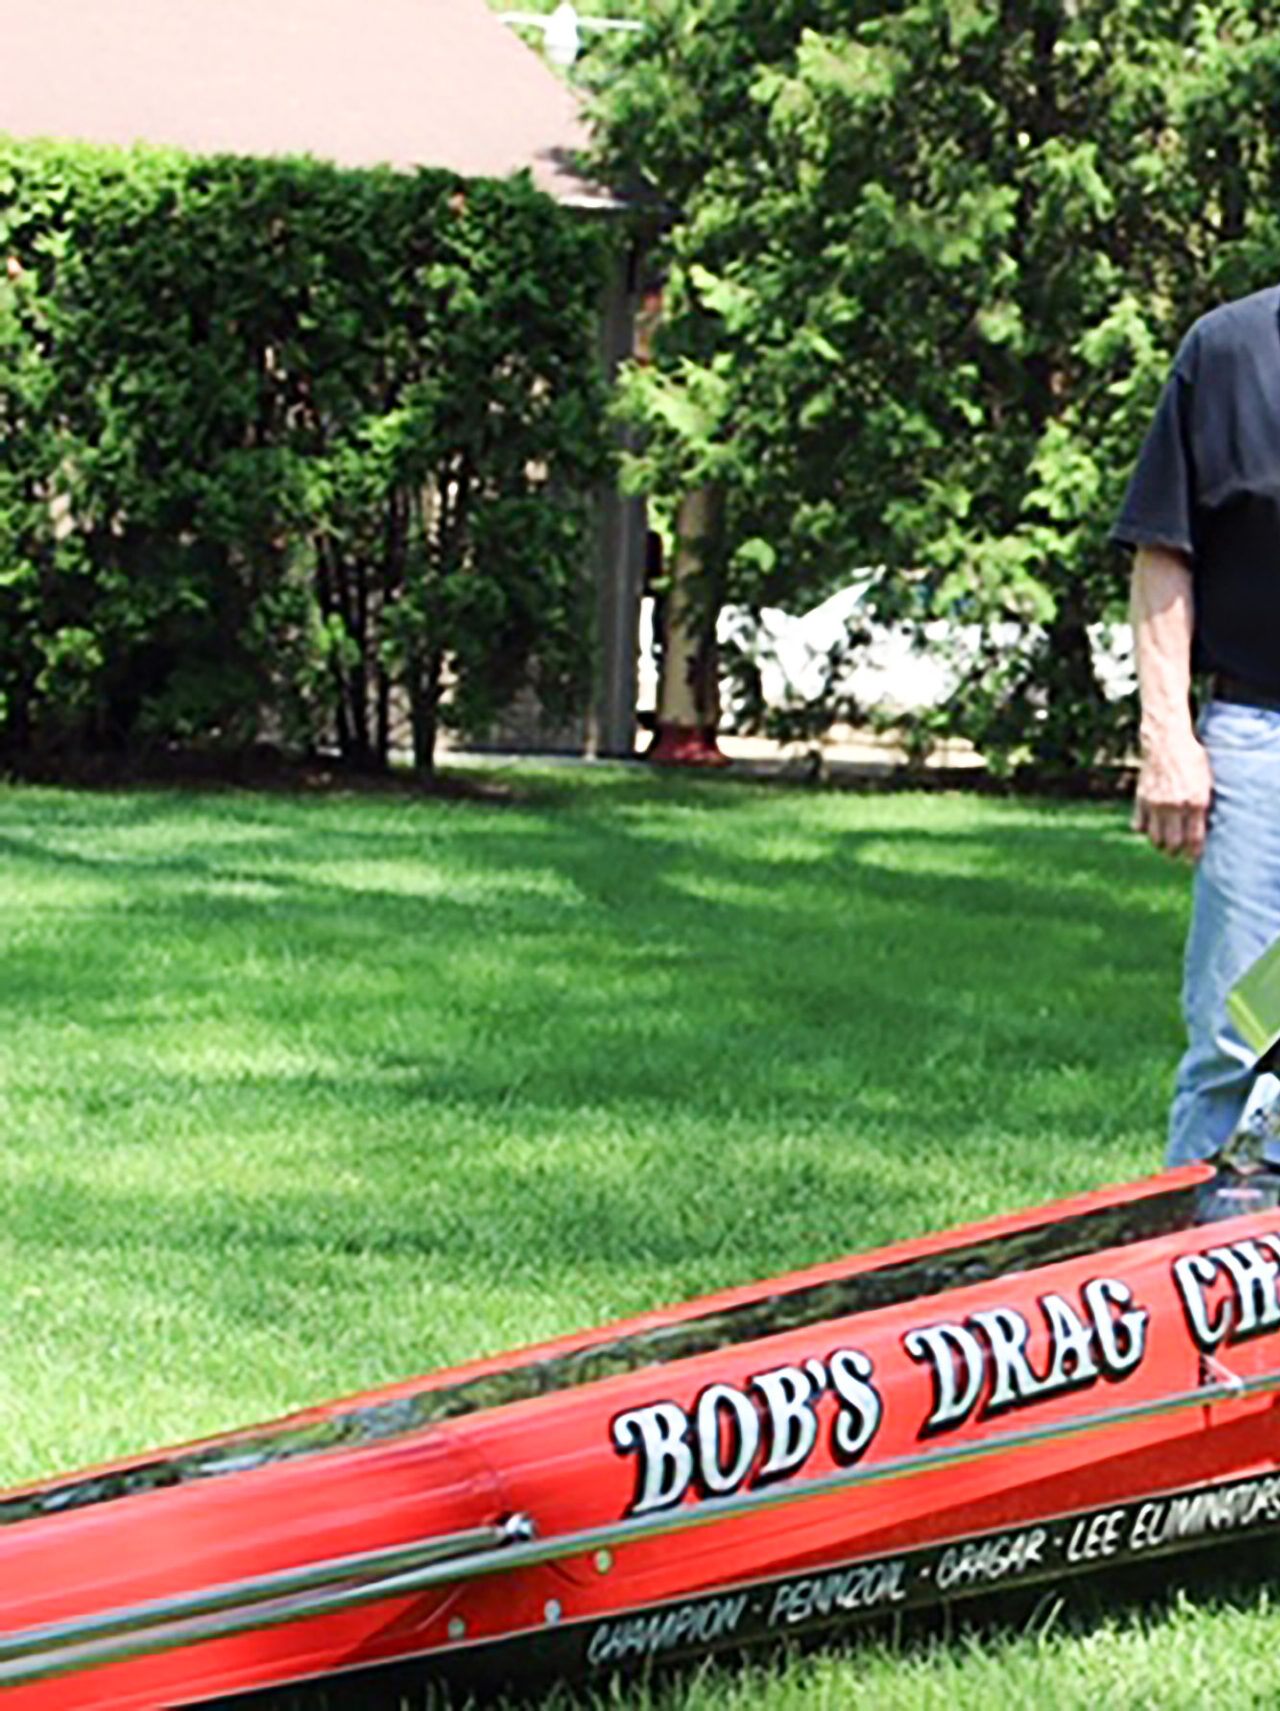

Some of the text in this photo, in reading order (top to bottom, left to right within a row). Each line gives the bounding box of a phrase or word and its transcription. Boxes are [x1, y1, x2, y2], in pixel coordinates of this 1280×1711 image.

[610, 1347, 883, 1517] BOB'S
[902, 1278, 1150, 1432] DRAG
[589, 1595, 747, 1665] CHAMPION
[768, 1561, 907, 1627] PENNZOIL
[1066, 1509, 1127, 1562] LEE
